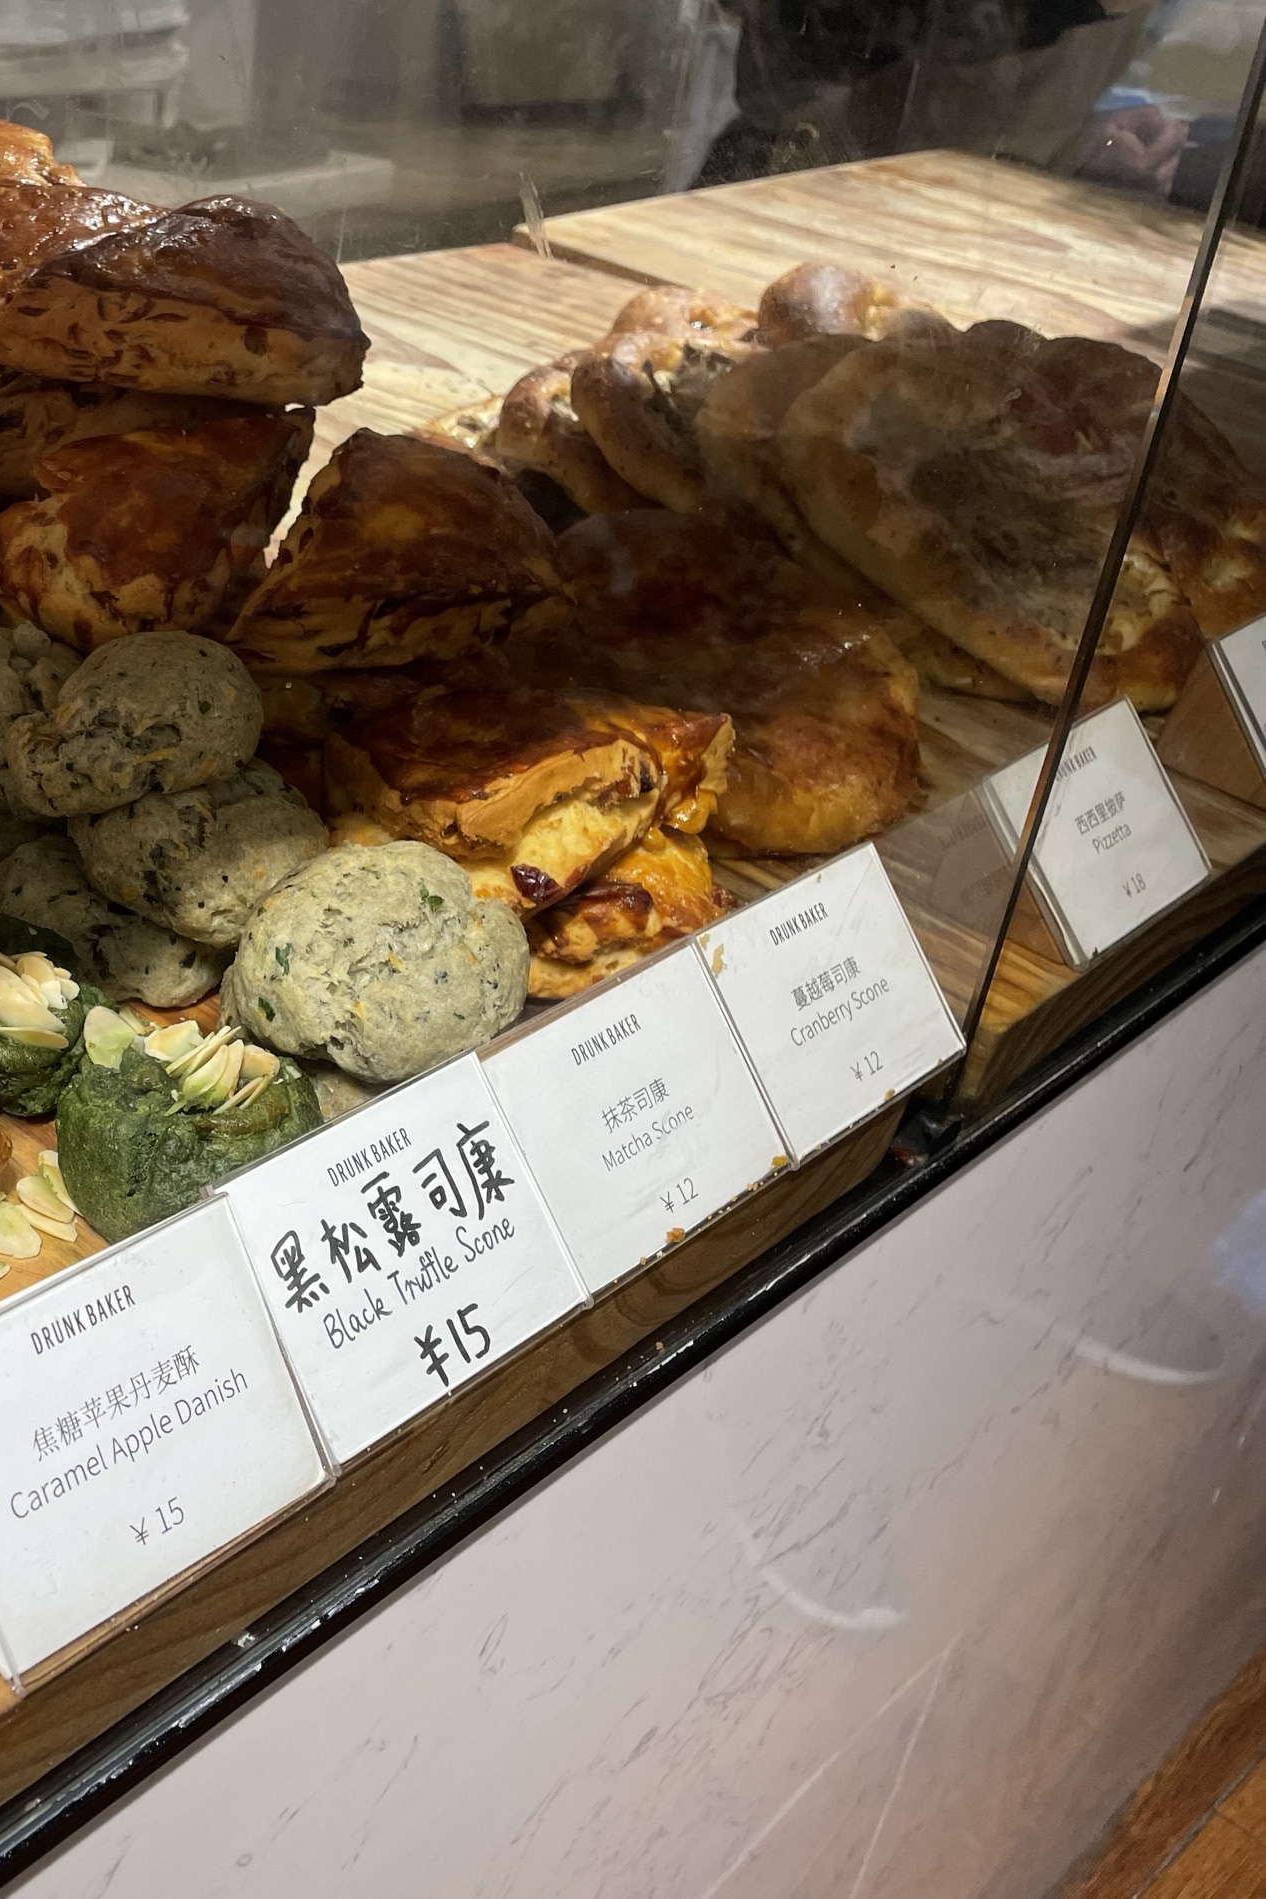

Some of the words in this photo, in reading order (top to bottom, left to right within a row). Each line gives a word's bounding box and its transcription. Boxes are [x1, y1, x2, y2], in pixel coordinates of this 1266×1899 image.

[1074, 790, 1126, 836] 西西里披萨
[1092, 823, 1132, 855] Pizzetta
[769, 916, 802, 946] DRUNK
[798, 902, 828, 930] BAKER
[790, 999, 853, 1046] Cranberry
[850, 978, 890, 1010] Scone
[791, 956, 861, 1011] 蔓越莓司康
[570, 1031, 610, 1066] DRUNK
[606, 1013, 642, 1045] BAKER
[864, 1051, 884, 1076] 12
[601, 1077, 670, 1134] 抹茶司康
[326, 1148, 374, 1188] DRUNK
[371, 1127, 412, 1164] BAKER
[601, 1133, 654, 1172] Matcha
[651, 1105, 695, 1140] Scone
[270, 1120, 516, 1313] 黑松露司康
[676, 1178, 699, 1206] 12
[322, 1288, 394, 1350] Black
[386, 1246, 459, 1306] Truffle
[455, 1217, 516, 1264] Scone
[30, 1308, 88, 1356] DRUNK
[85, 1284, 137, 1328] BAKER
[32, 1344, 201, 1462] 焦糖苹果丹麦酥
[9, 1443, 109, 1519] Caramel
[112, 1413, 174, 1462] Apple
[175, 1367, 250, 1426] Danish
[155, 1496, 186, 1536] 15
